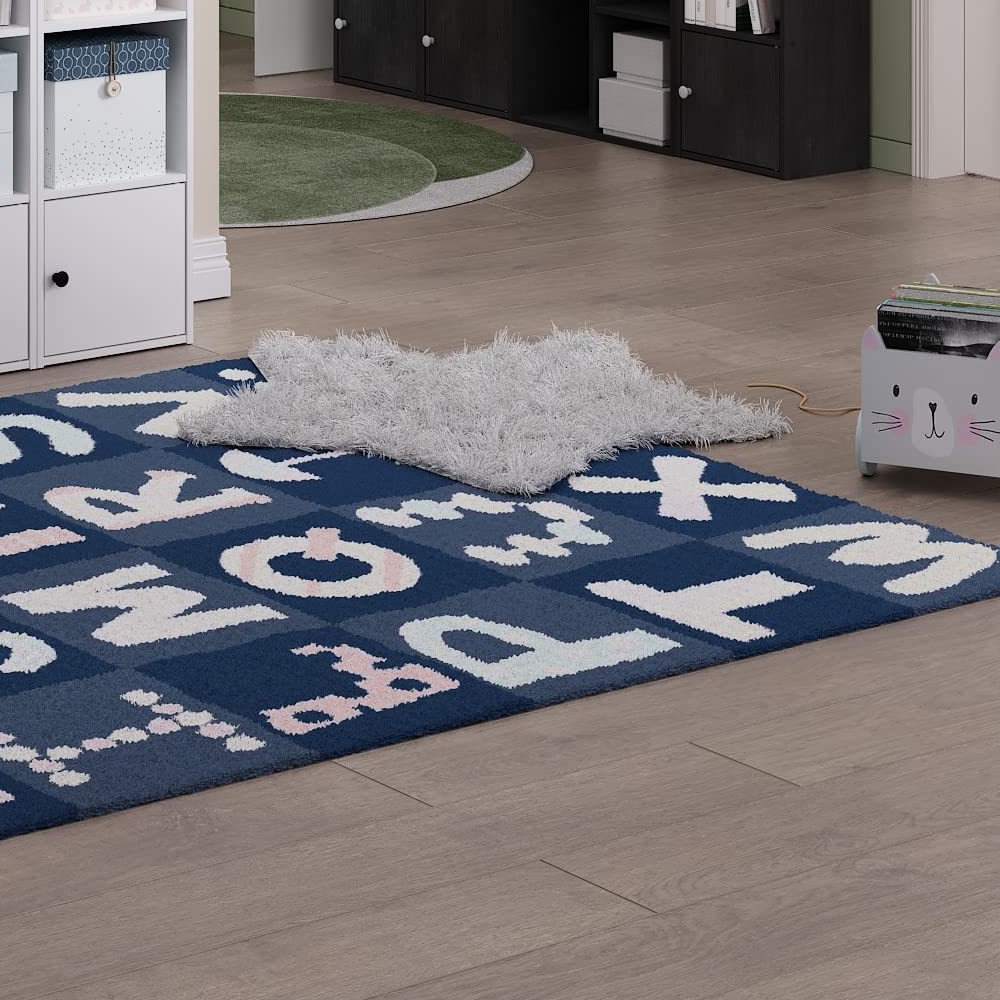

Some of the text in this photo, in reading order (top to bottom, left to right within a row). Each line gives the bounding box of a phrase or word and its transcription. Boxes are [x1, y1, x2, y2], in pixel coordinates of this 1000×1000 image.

[43, 469, 273, 531] R
[568, 454, 797, 521] X
[0, 562, 289, 648] M
[585, 570, 815, 643] T
[399, 614, 683, 690] P
